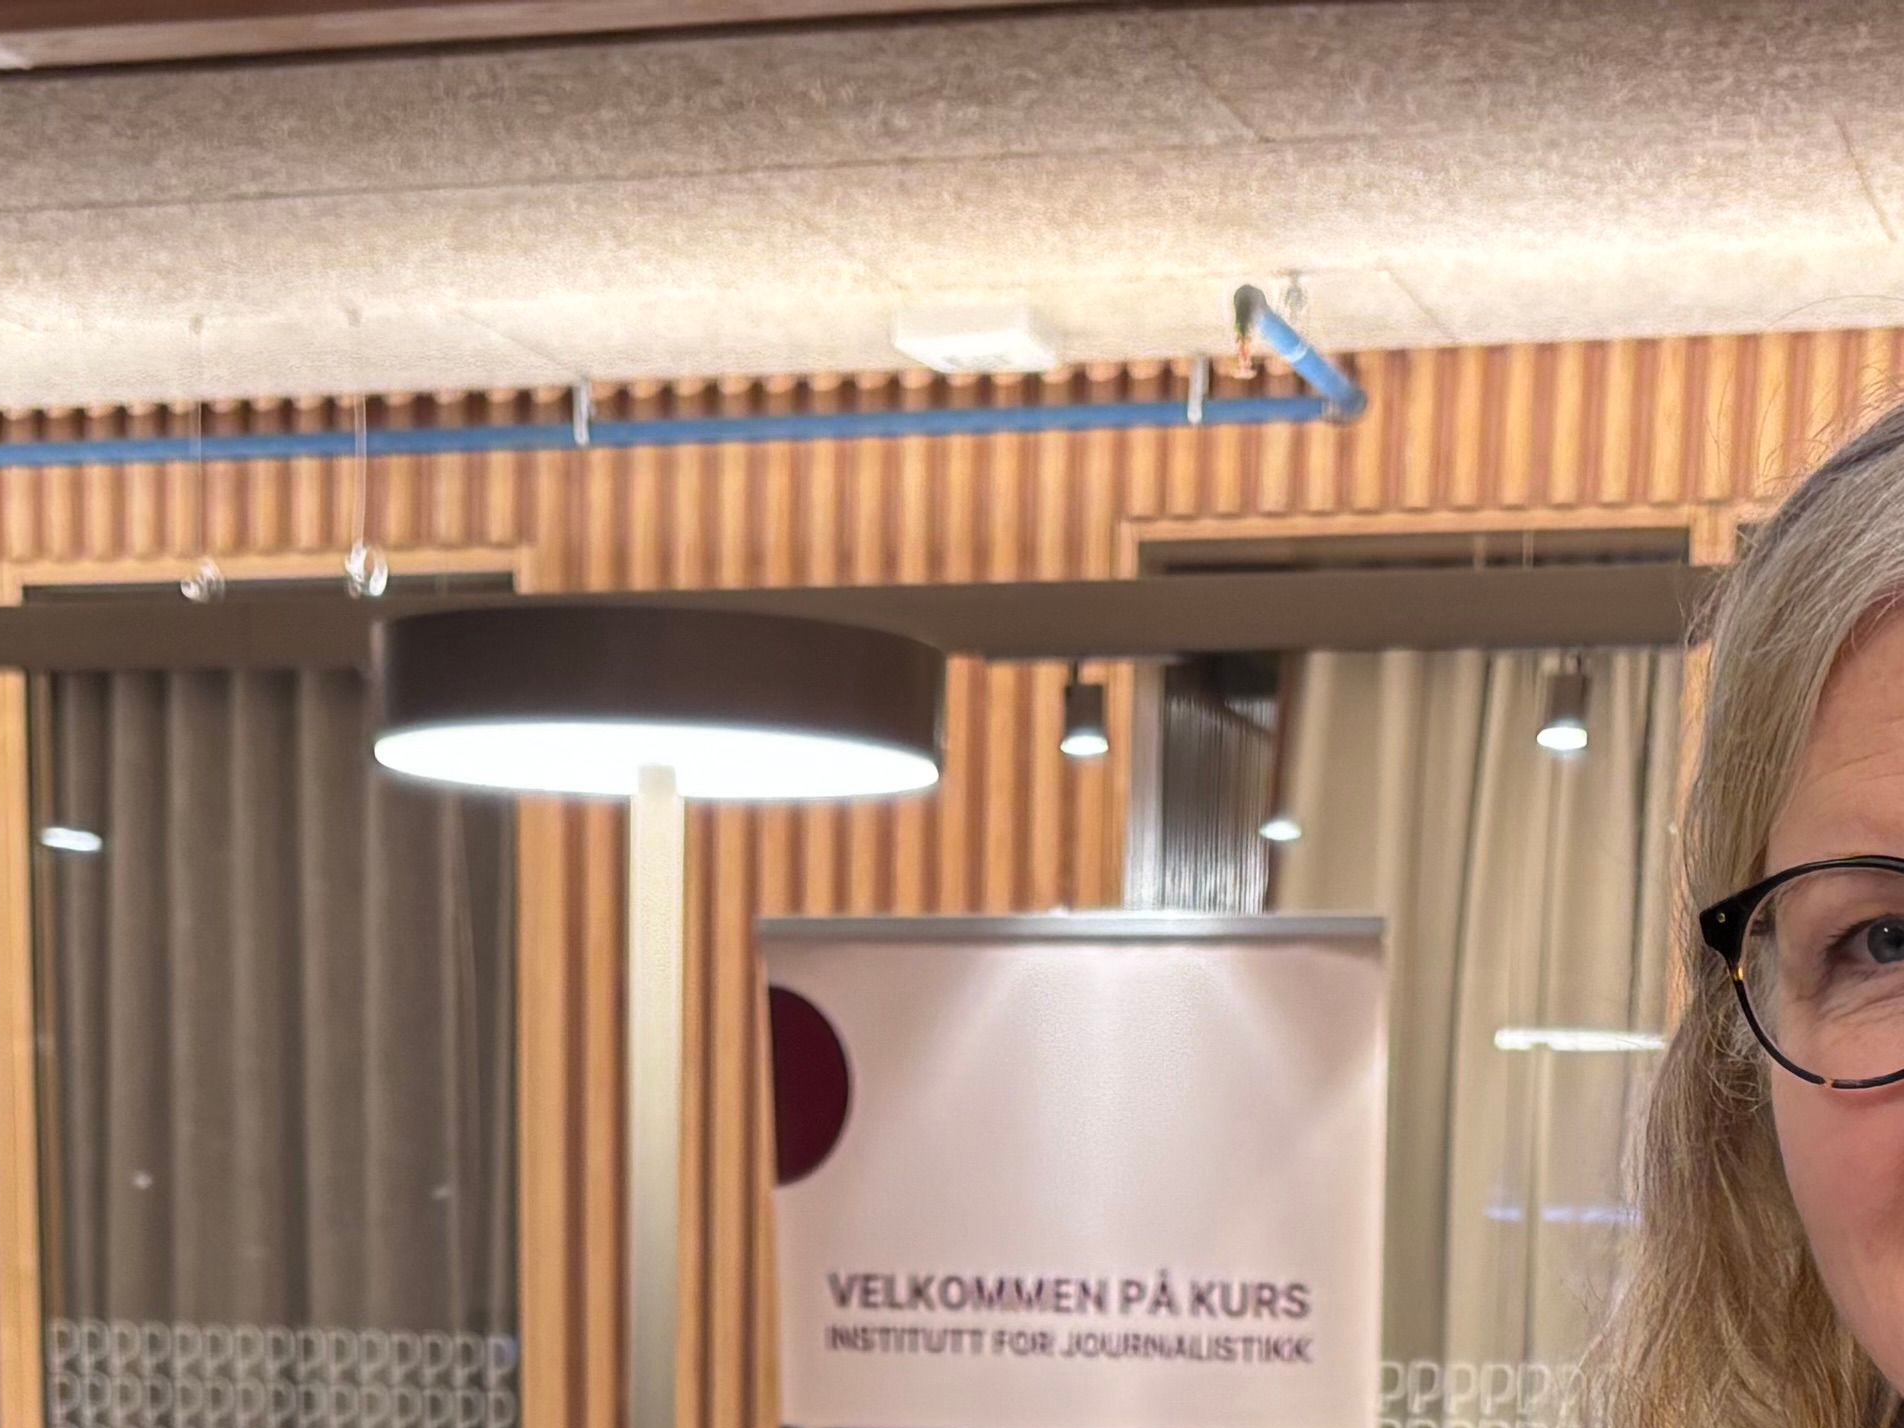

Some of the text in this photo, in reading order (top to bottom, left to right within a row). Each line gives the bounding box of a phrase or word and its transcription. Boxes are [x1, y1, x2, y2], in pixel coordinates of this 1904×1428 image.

[826, 1269, 1313, 1320] VELKOMMEN PÅ KURS
[825, 1326, 1315, 1364] INSTITUTT FOR JOURNALISTIKK
